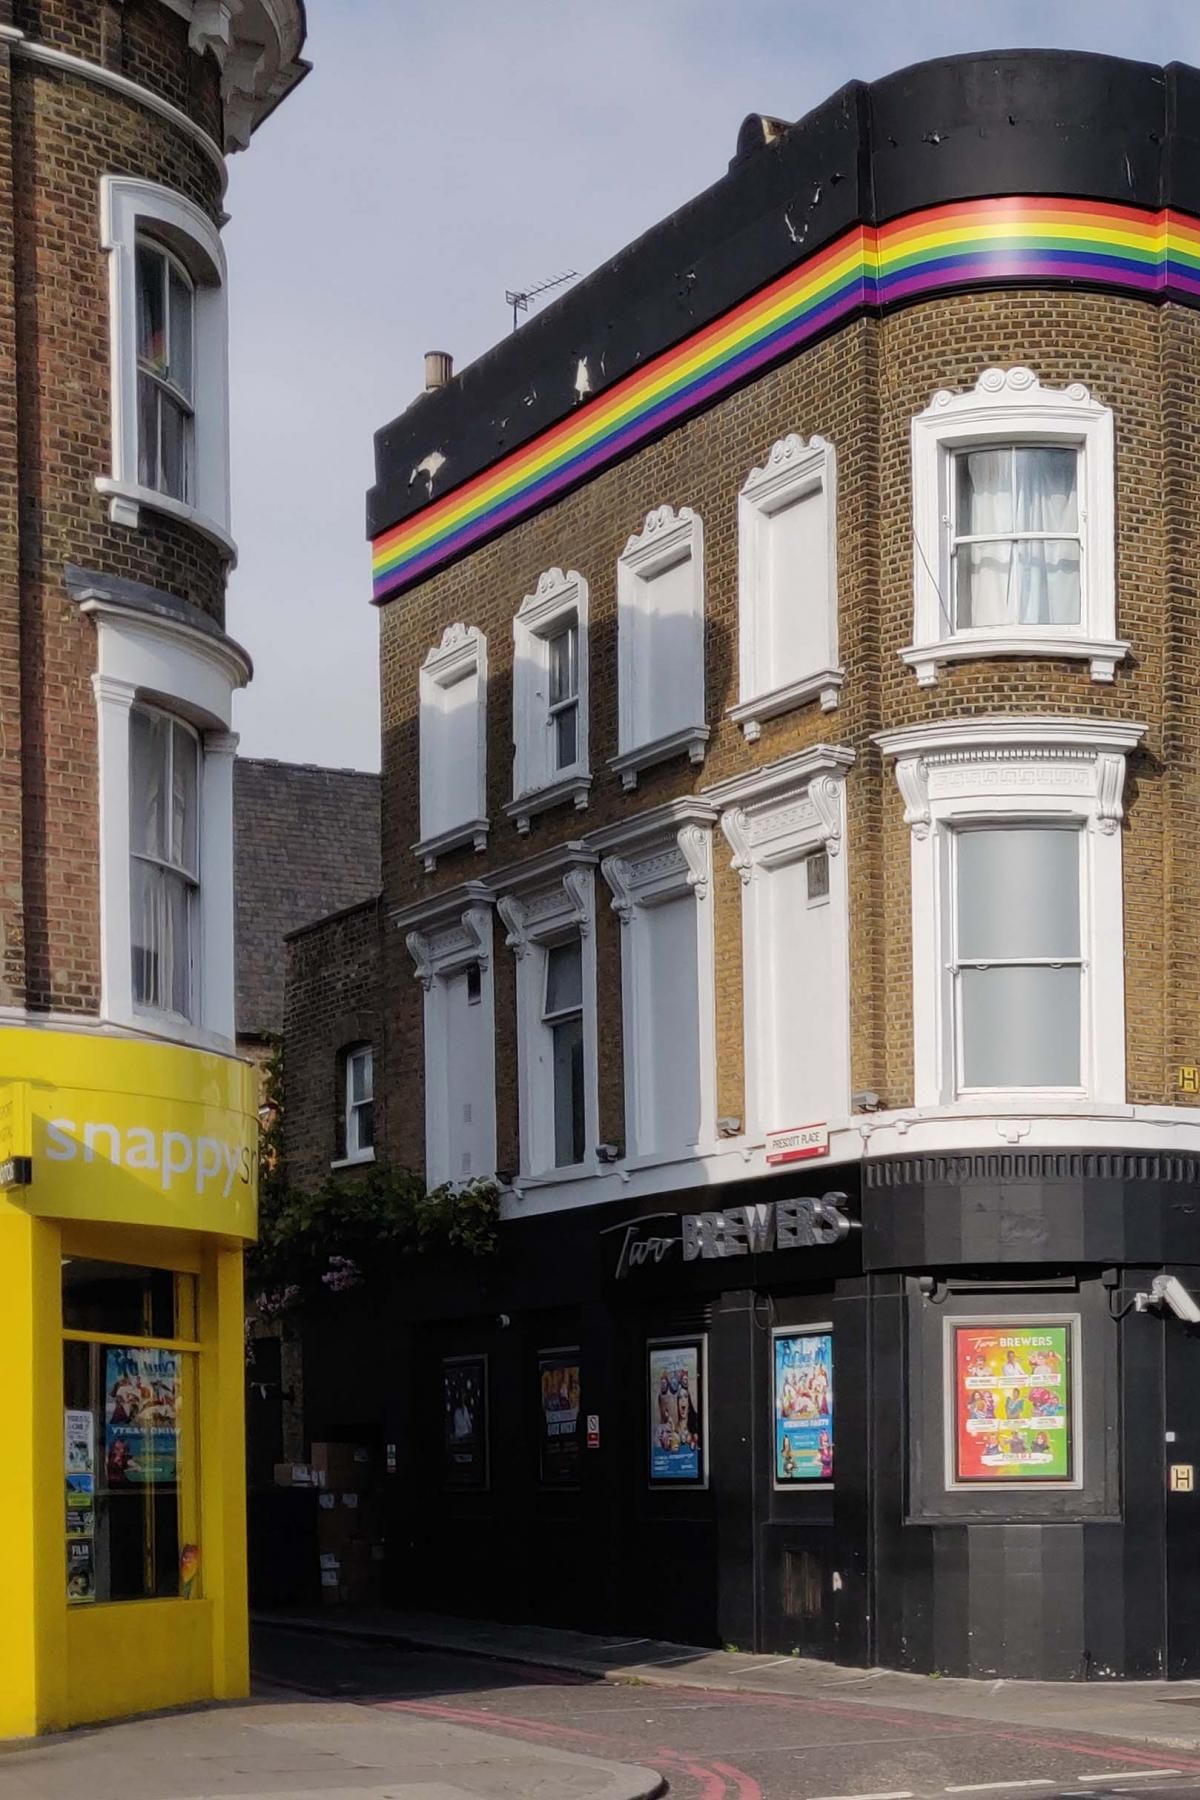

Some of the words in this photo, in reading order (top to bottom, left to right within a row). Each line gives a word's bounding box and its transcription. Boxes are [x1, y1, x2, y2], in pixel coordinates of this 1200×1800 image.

[772, 1135, 800, 1149] PRESCOTT
[801, 1131, 821, 1145] PLACE
[600, 1212, 683, 1280] Two
[682, 1191, 850, 1262] BREWERS
[999, 1336, 1053, 1347] BREWERS
